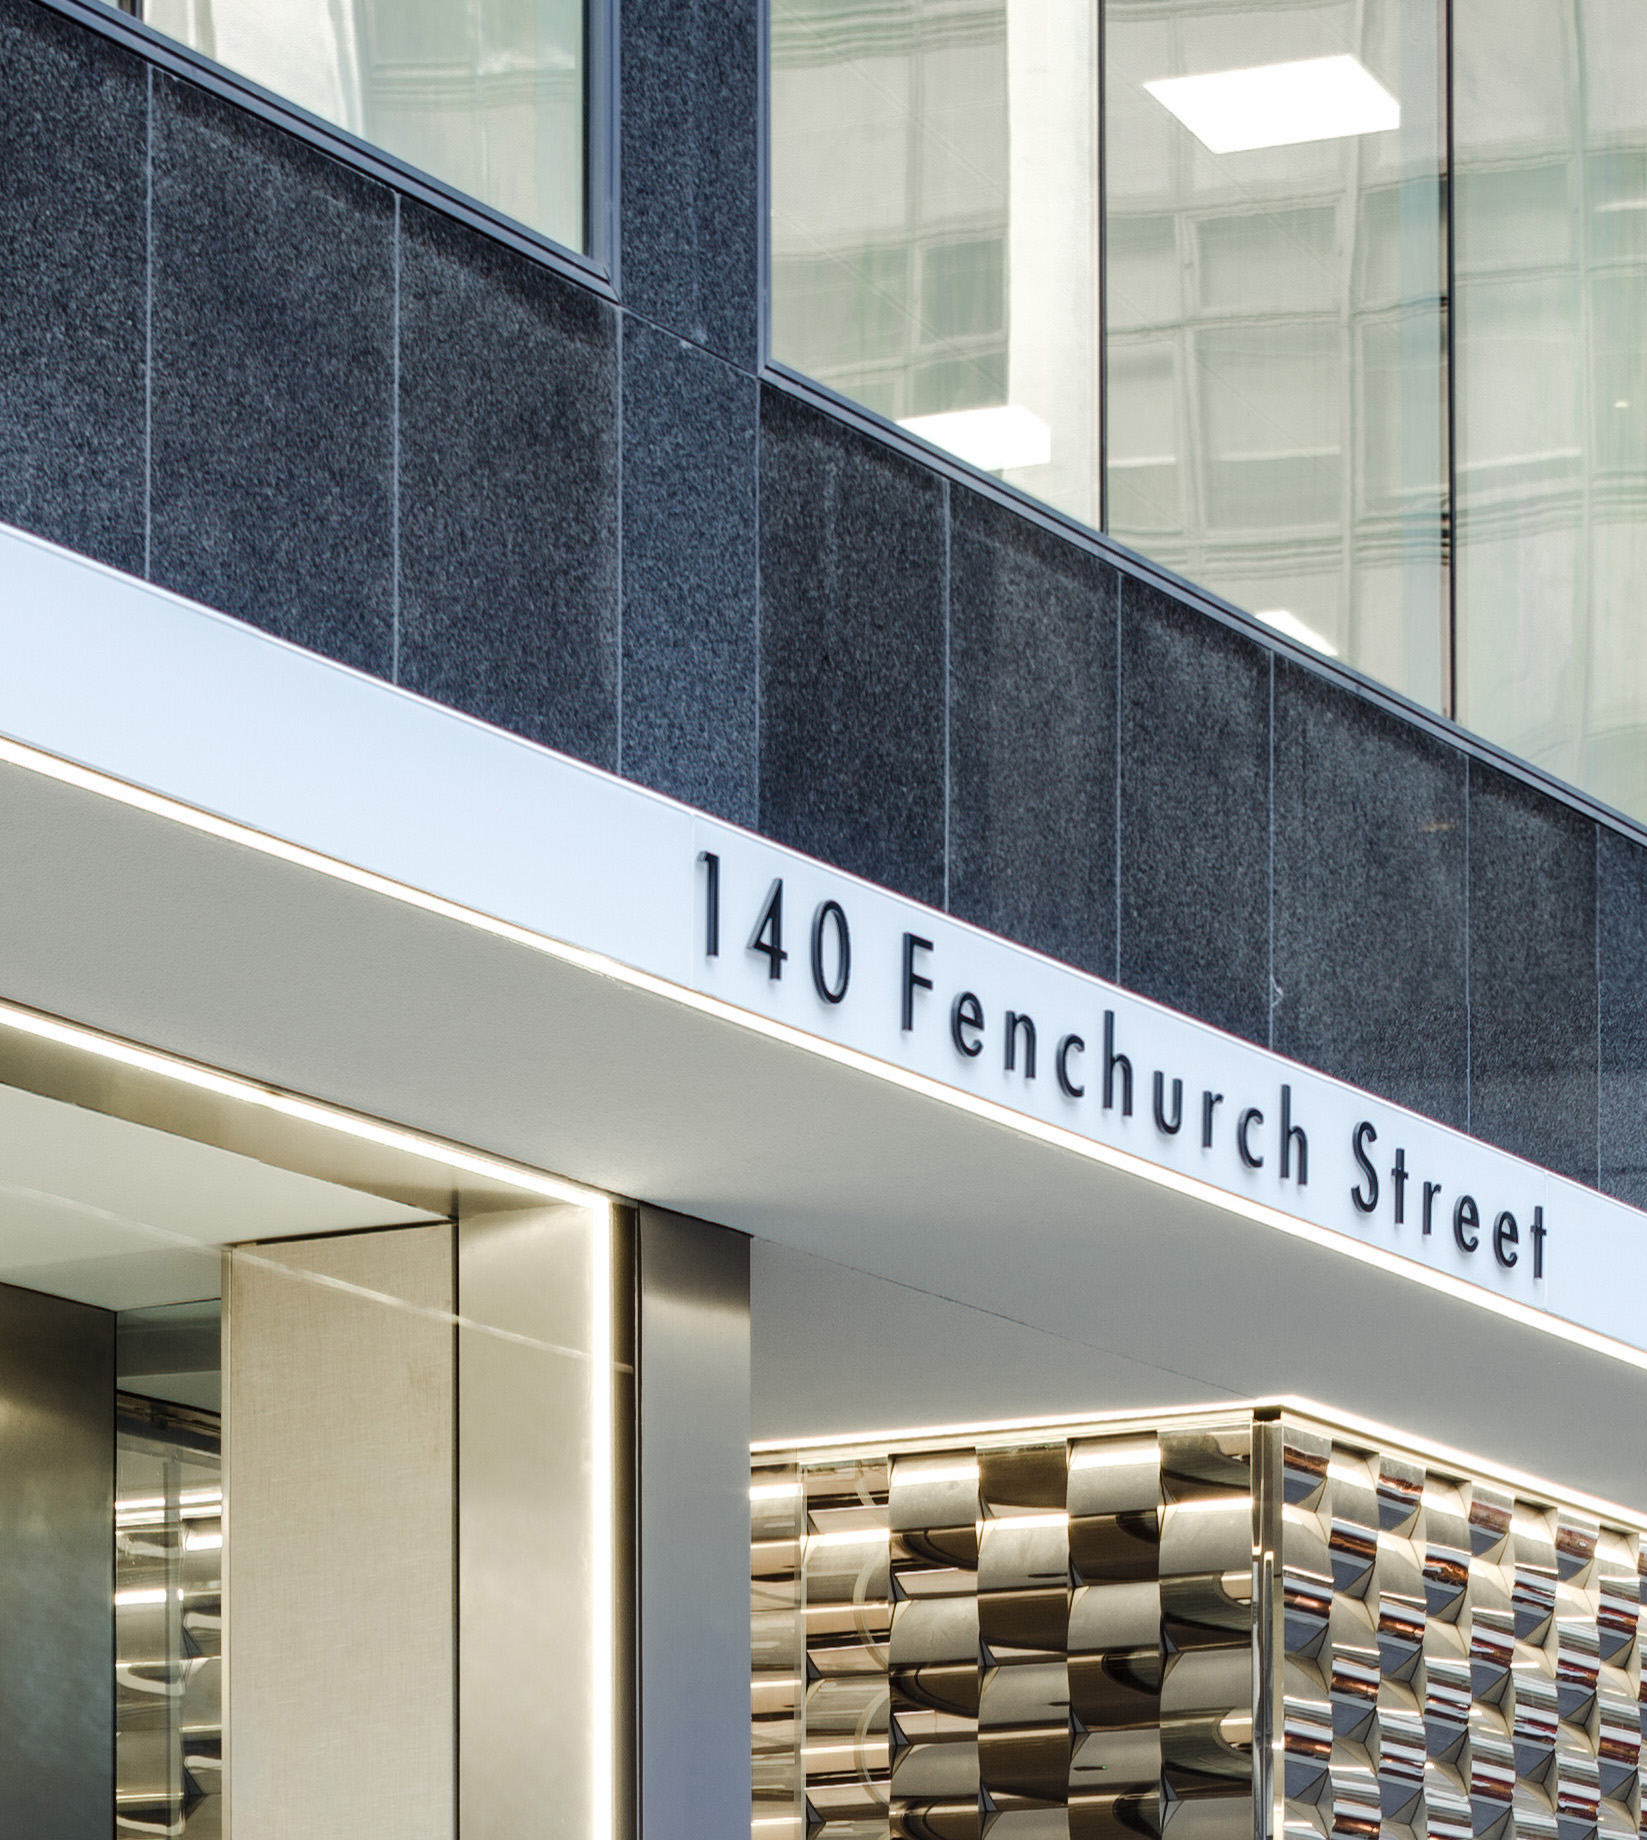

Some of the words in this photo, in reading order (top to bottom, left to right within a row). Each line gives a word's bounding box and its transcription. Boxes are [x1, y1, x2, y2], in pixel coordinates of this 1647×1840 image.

[696, 850, 851, 1005] 140
[900, 932, 1309, 1187] Fenchurch
[1350, 1120, 1548, 1281] Street
